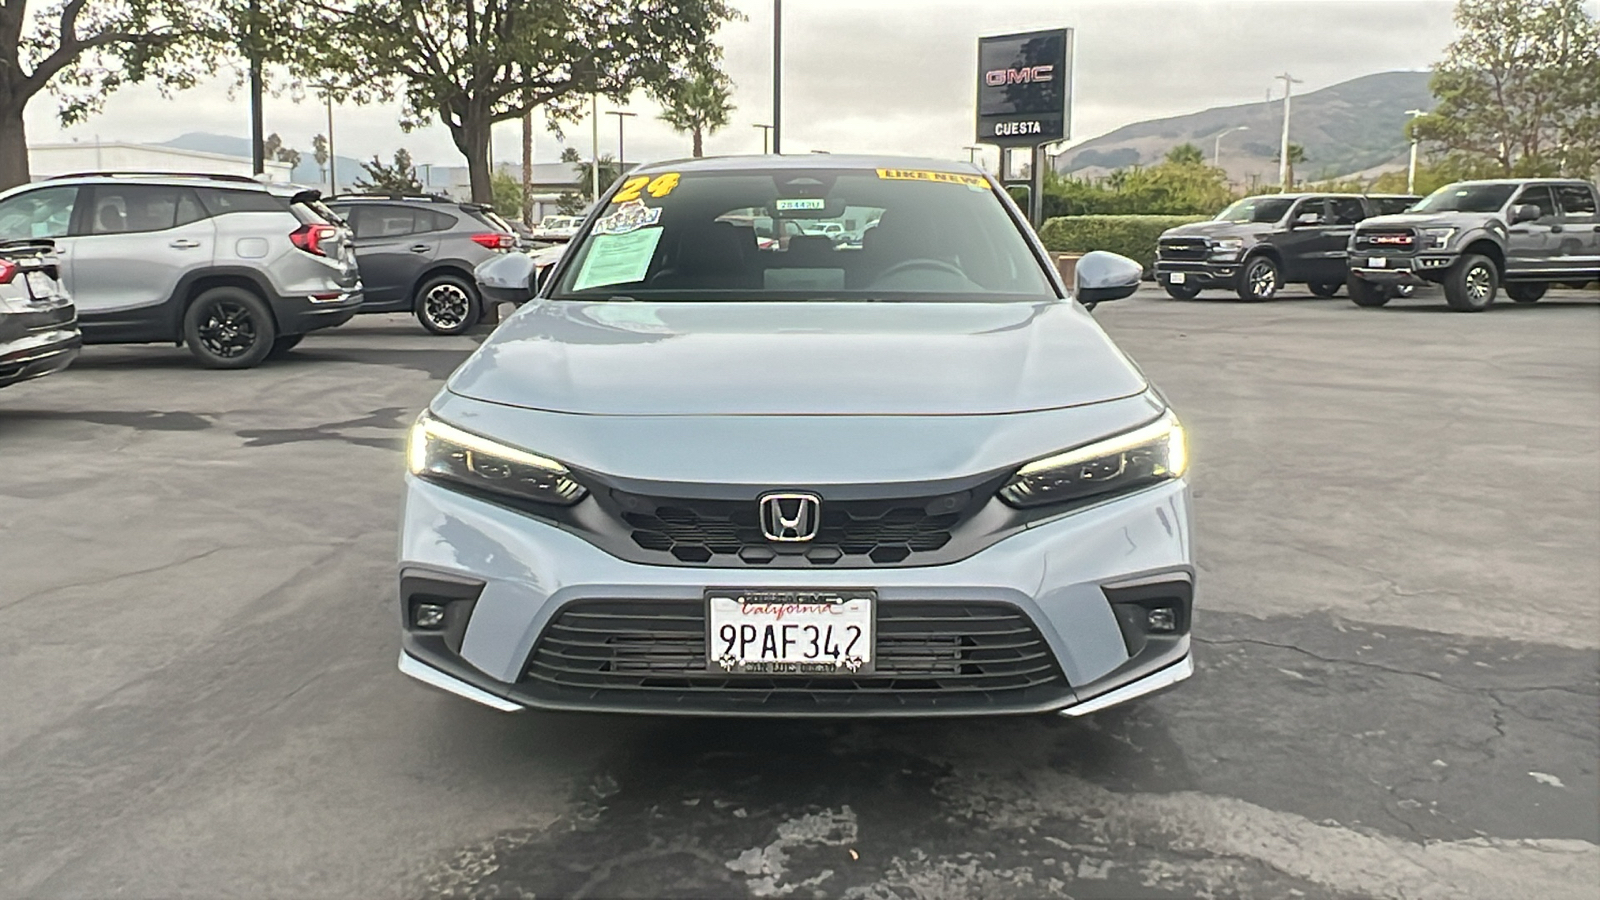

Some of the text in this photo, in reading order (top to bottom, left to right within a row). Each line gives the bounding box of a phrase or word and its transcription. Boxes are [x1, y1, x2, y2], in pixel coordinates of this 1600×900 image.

[986, 65, 1053, 86] GMC
[995, 121, 1041, 135] CUESTA
[885, 169, 981, 186] LIKE NEW
[612, 173, 680, 203] 24
[742, 603, 843, 621] California
[719, 624, 861, 659] 9PAF342
